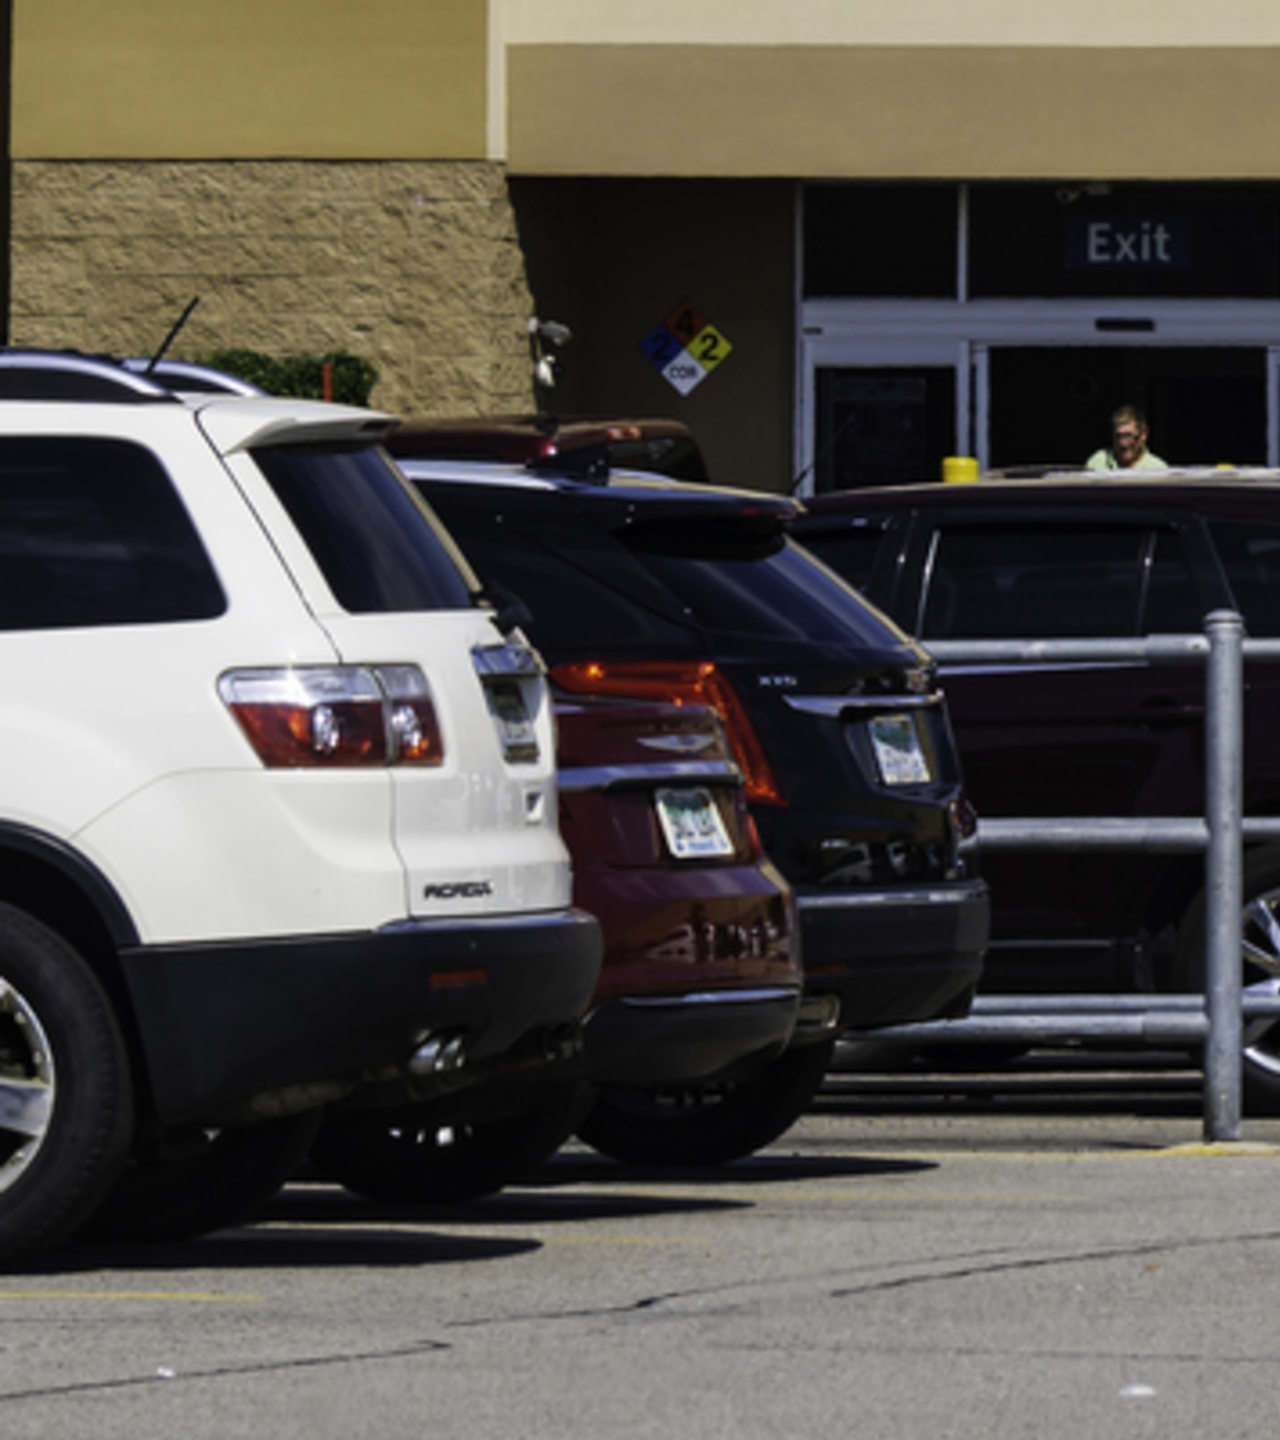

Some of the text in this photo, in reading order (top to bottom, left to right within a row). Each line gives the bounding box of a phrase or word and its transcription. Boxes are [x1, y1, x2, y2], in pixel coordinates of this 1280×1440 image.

[1087, 222, 1171, 262] Exit
[675, 310, 694, 334] 4
[653, 333, 672, 360] 2
[701, 334, 720, 360] 2
